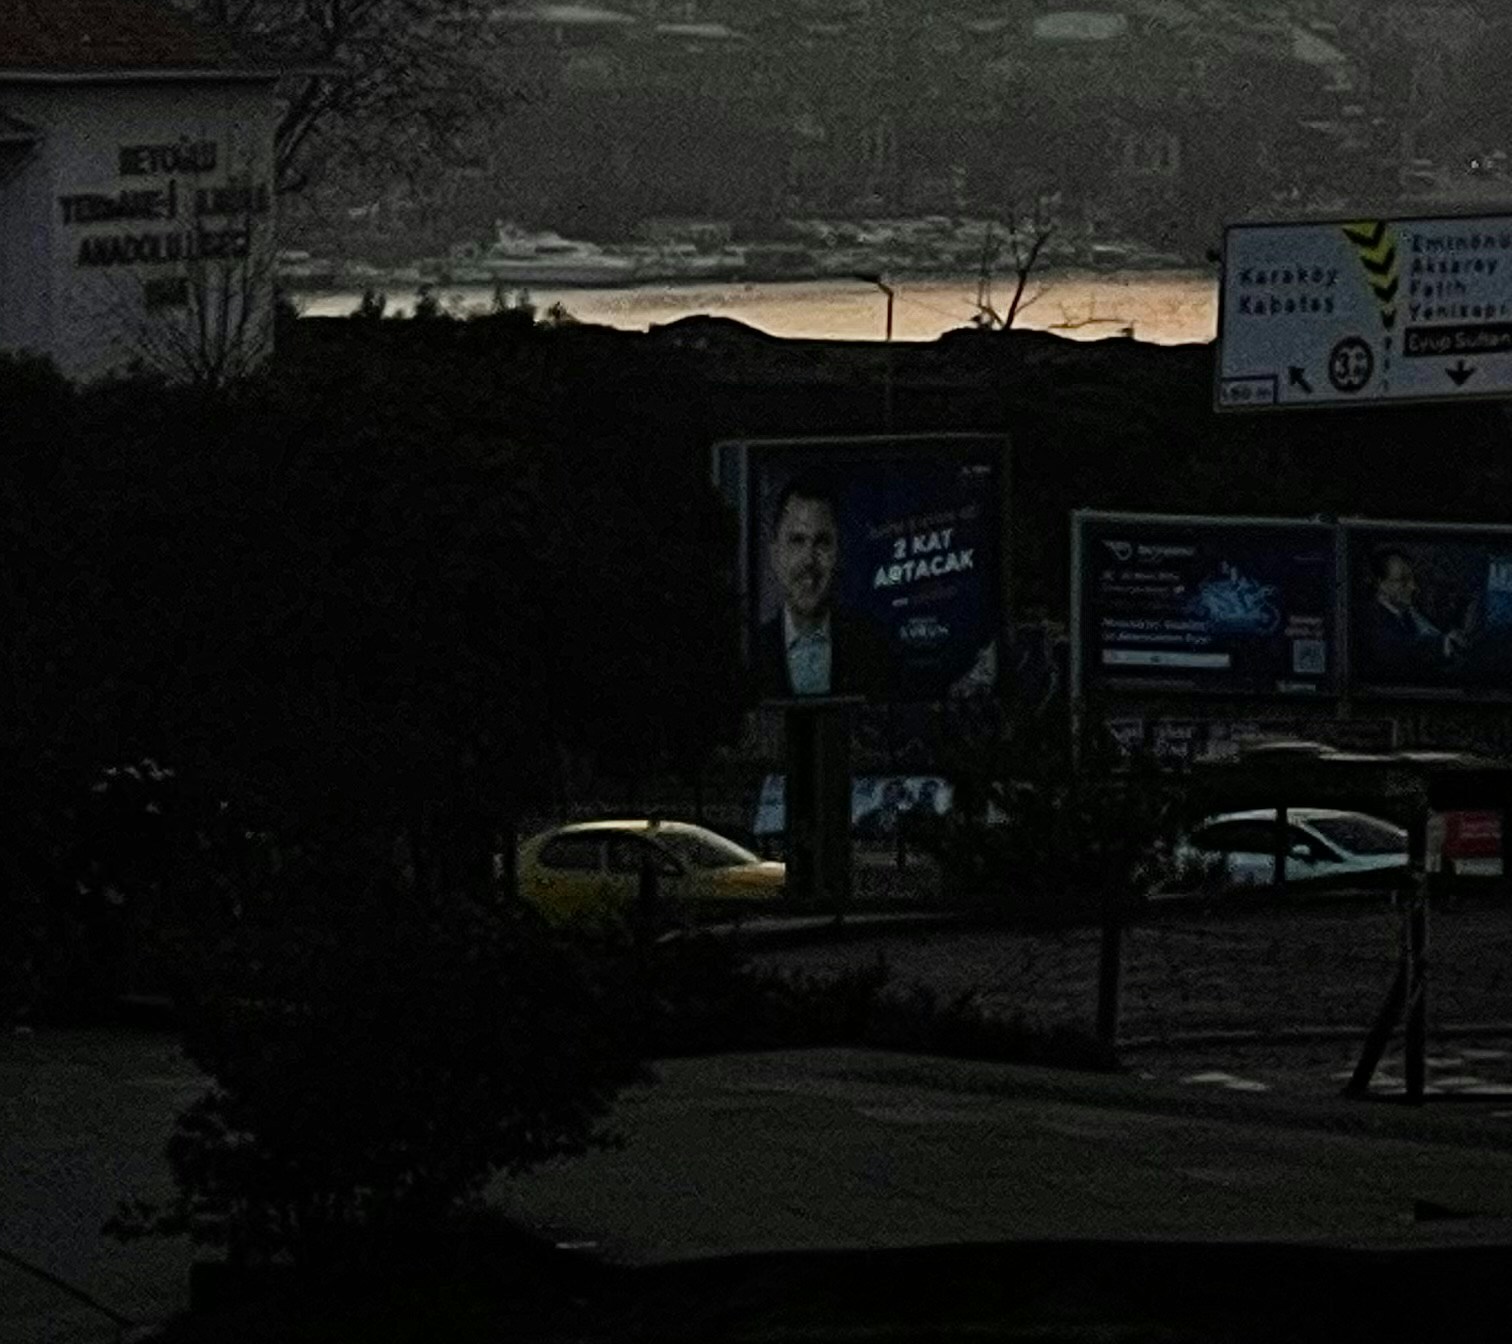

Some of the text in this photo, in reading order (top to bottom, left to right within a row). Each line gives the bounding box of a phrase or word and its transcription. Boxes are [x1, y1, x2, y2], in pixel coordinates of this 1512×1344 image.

[892, 528, 954, 561] 2 KAT
[872, 548, 975, 590] ARTACAK
